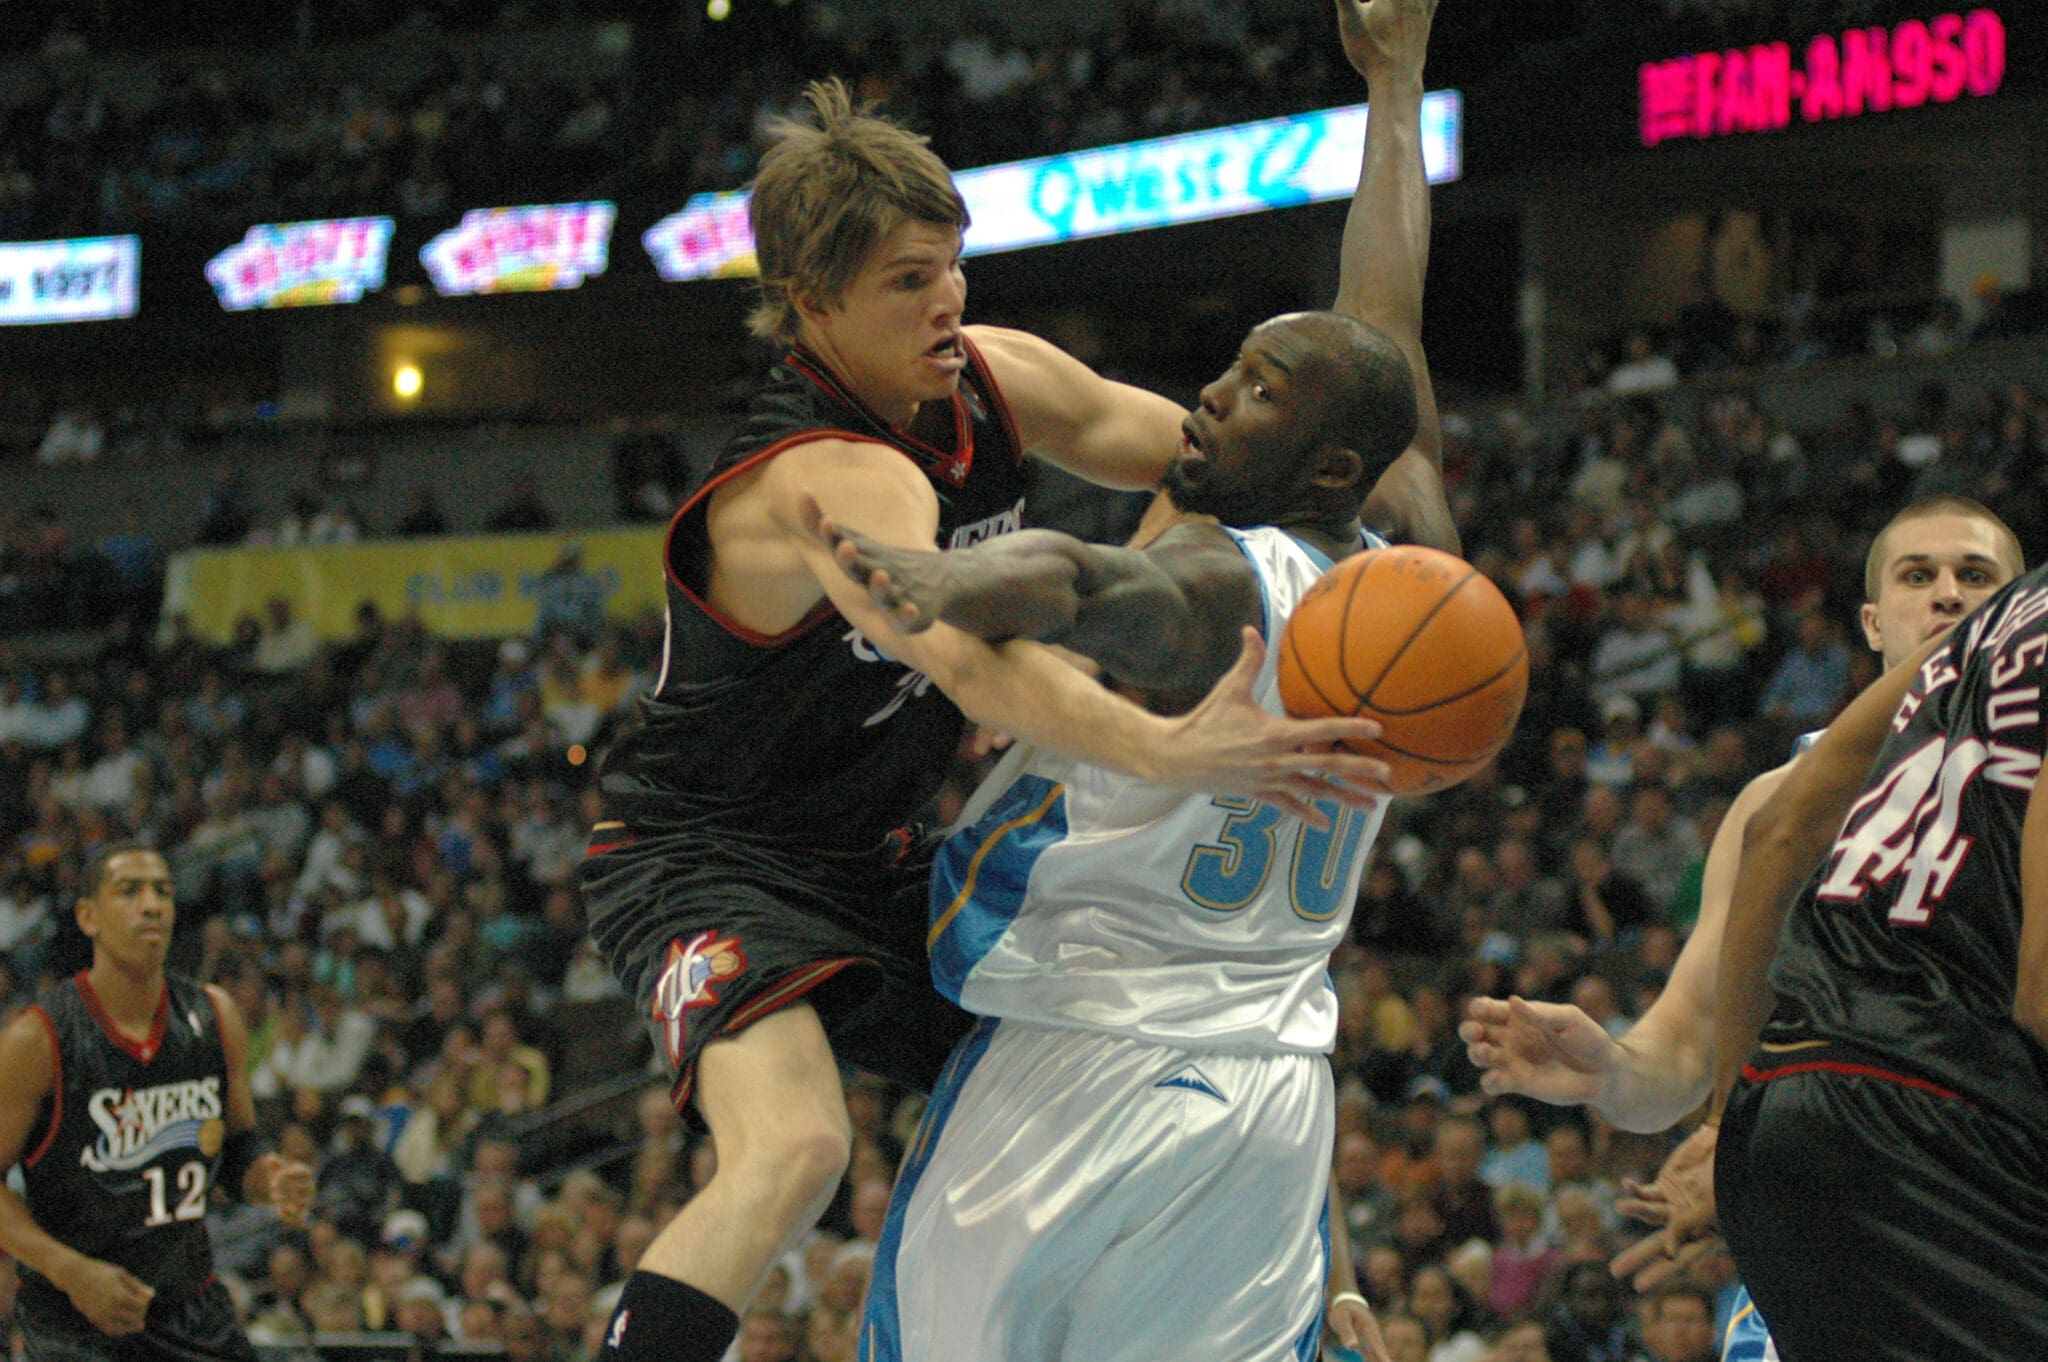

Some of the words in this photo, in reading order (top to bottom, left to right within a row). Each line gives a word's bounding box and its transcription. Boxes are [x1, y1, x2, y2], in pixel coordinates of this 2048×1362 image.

[1181, 772, 1371, 922] 30
[1816, 732, 1990, 926] 44
[142, 1161, 207, 1226] 12
